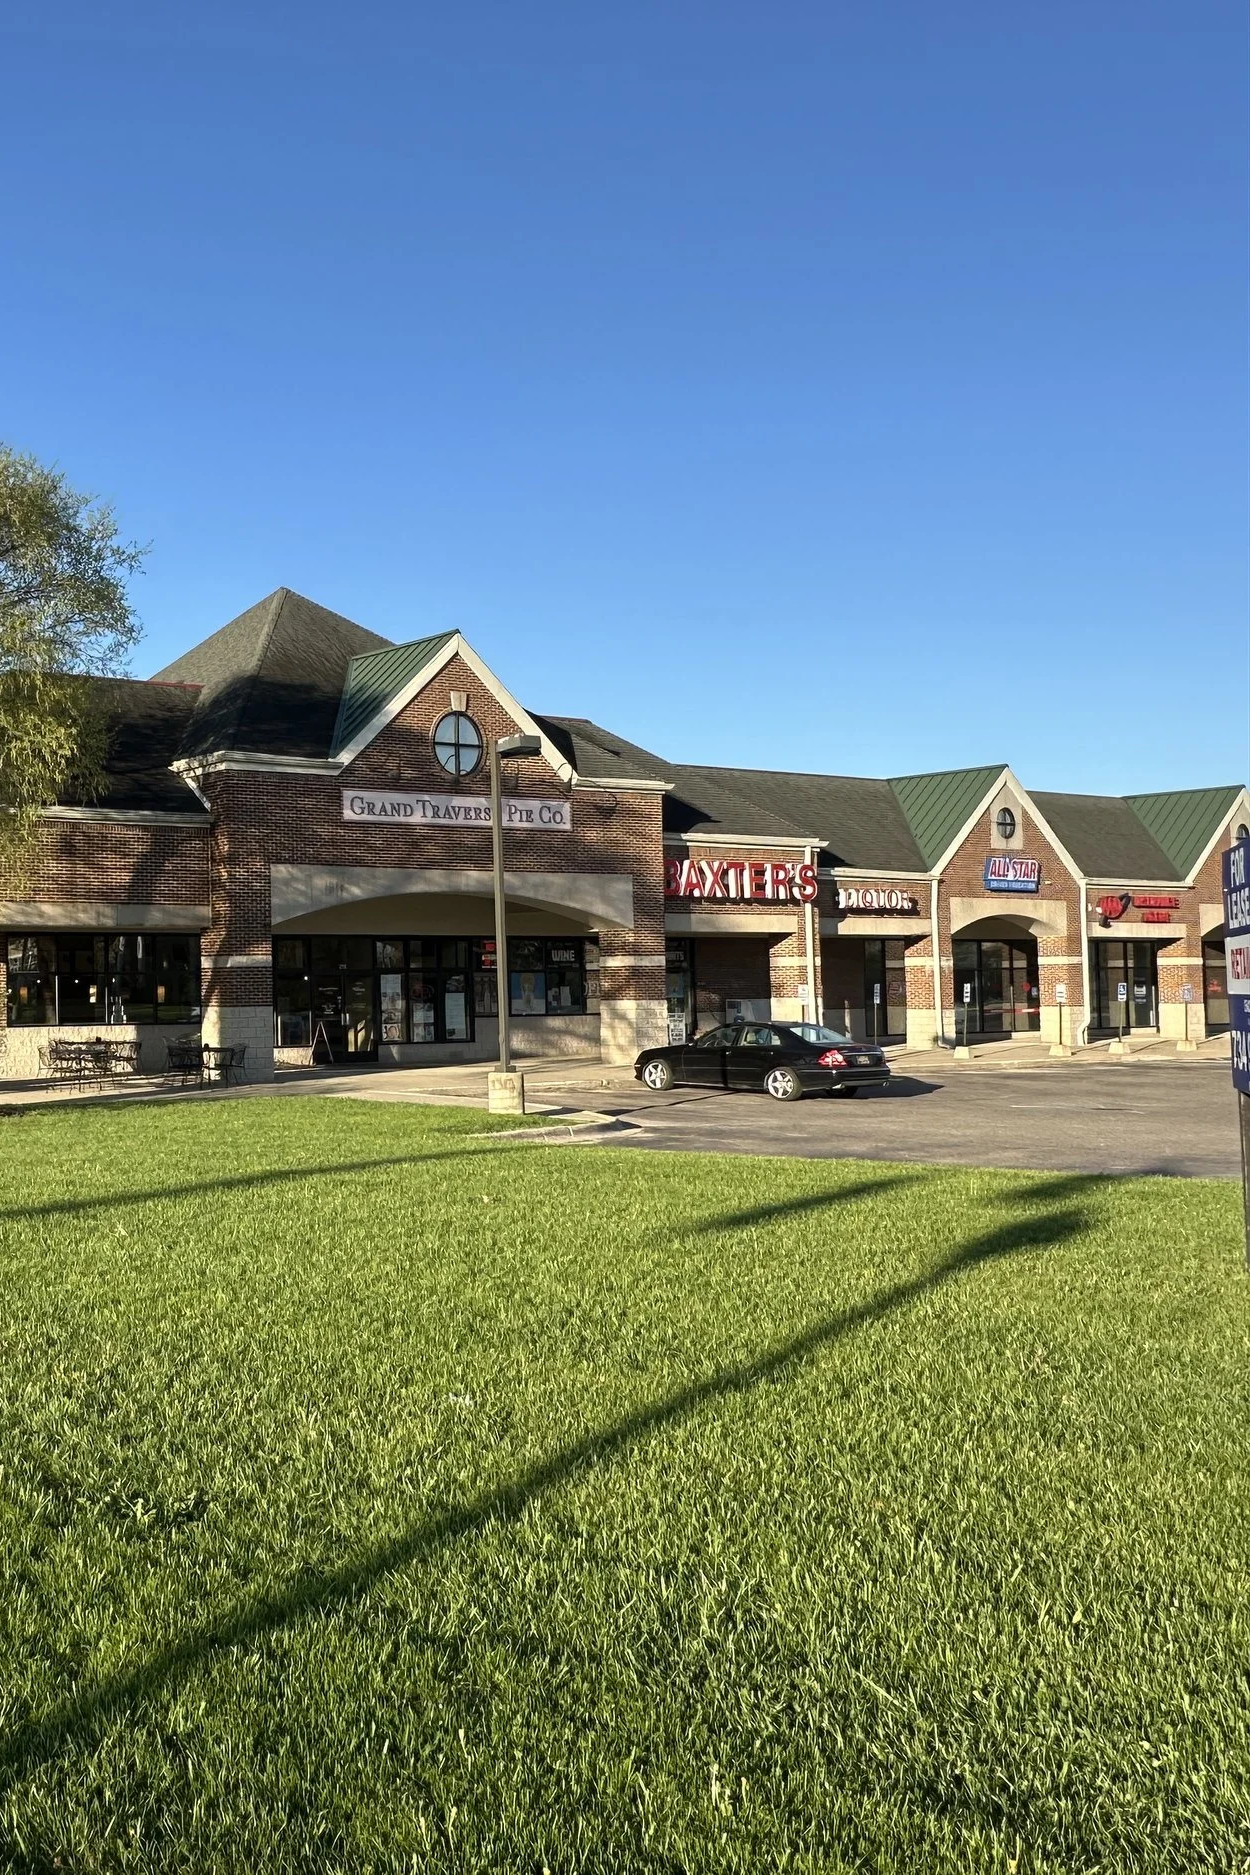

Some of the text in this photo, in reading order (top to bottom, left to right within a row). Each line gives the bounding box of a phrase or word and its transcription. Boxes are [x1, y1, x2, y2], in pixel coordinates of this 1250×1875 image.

[416, 799, 491, 821] TRAVERS
[1011, 860, 1038, 880] STAR
[1230, 847, 1245, 888] FOR
[664, 859, 818, 901] BAXTER'S
[838, 888, 915, 910] LIQUOR
[1228, 887, 1250, 929] LEASE
[551, 949, 575, 962] WINE
